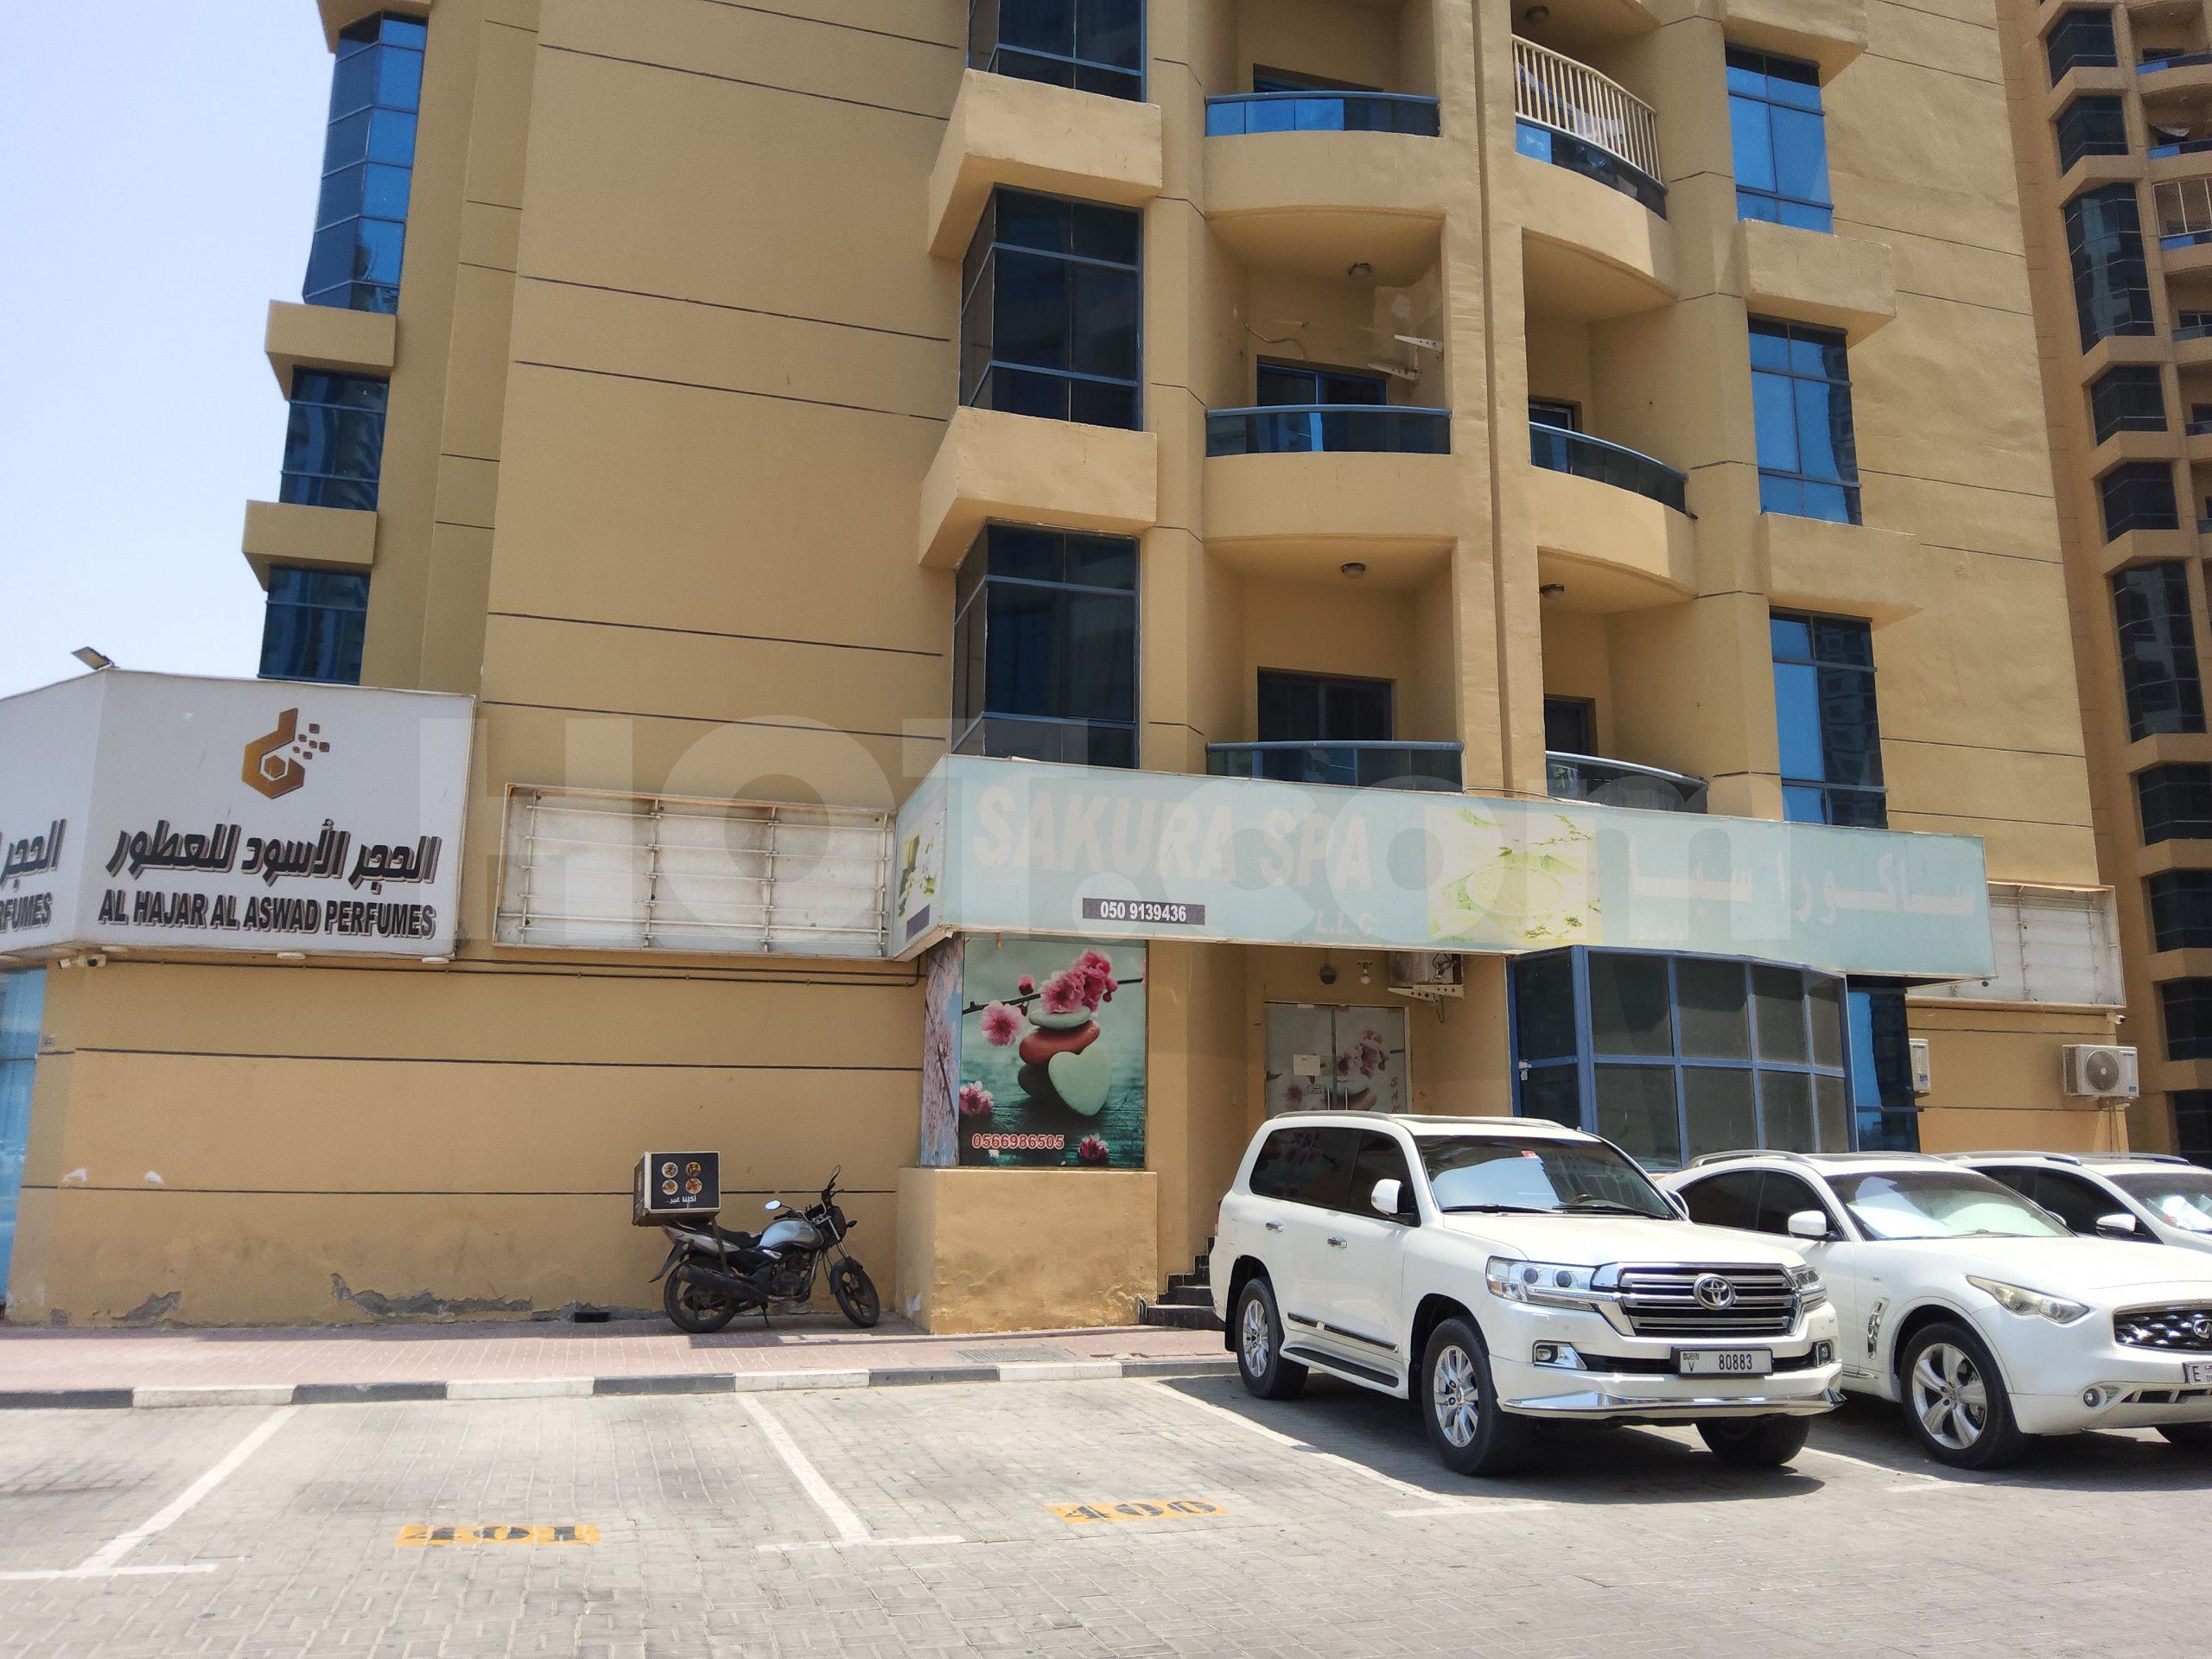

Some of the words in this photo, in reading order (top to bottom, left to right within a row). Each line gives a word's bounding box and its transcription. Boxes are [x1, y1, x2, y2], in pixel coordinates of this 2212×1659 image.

[974, 786, 1237, 880] SAKURA
[1262, 809, 1373, 890] SPA
[105, 819, 242, 880] للعطور
[240, 818, 351, 887] الأسود
[348, 835, 442, 894] الحجر
[98, 888, 130, 925] AL
[133, 890, 209, 929] HAJAR
[209, 894, 240, 931] AL
[243, 895, 321, 935] ASWAD
[323, 899, 436, 940] PERFUMES
[1100, 900, 1126, 919] 050
[1129, 902, 1187, 923] 9139436
[971, 1133, 1065, 1150] 0566986505
[1688, 1361, 1694, 1372] V
[1718, 1353, 1752, 1371] 80883
[2192, 1365, 2202, 1382] E
[1064, 1499, 1218, 1521] 400
[404, 1526, 591, 1541] 401
